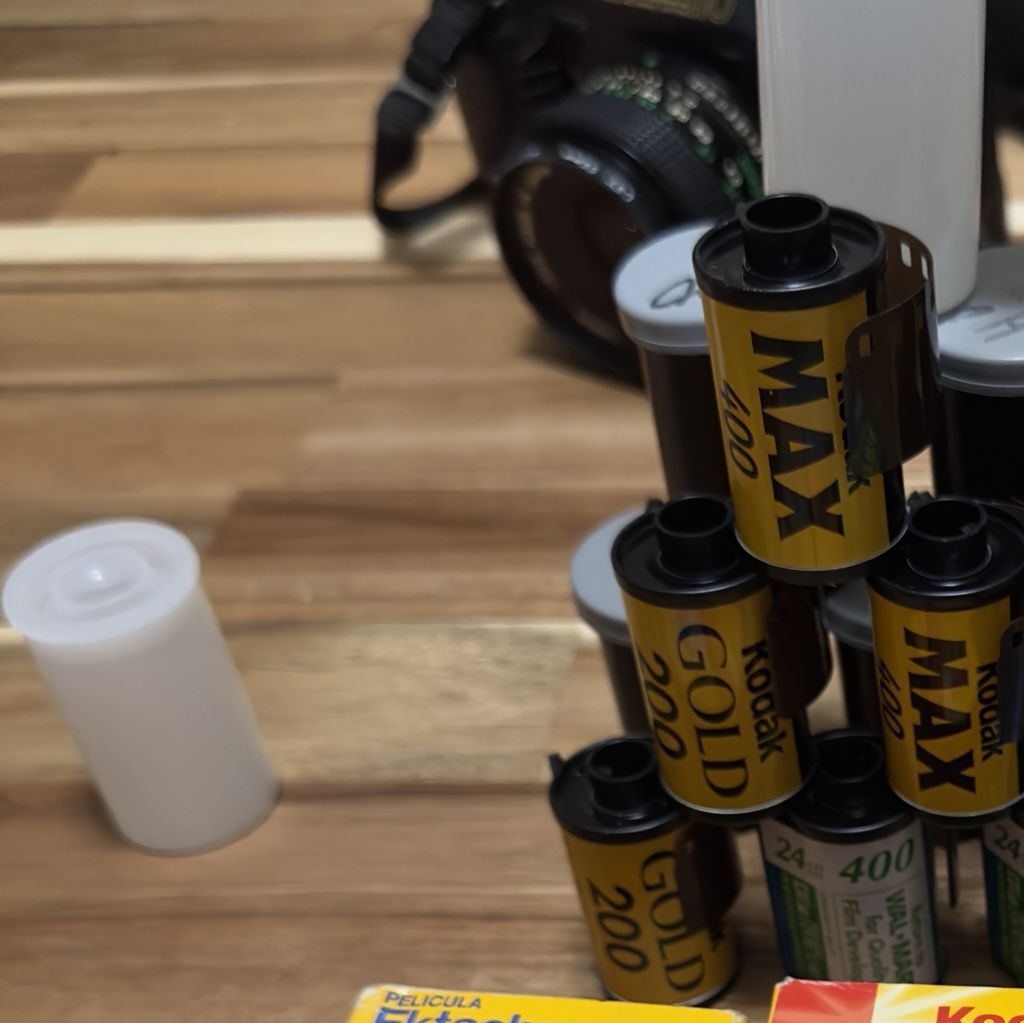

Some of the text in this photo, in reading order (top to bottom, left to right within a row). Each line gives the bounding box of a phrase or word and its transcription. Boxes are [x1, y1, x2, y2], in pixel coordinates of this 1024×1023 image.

[722, 380, 759, 480] 400
[750, 330, 845, 542] MAX
[637, 644, 687, 761] 200
[676, 623, 750, 799] GOLD
[741, 639, 784, 763] Kodak
[903, 626, 977, 795] MAX
[975, 662, 1004, 762] Kodak
[776, 836, 806, 870] 24
[838, 838, 915, 885] 400
[993, 824, 1021, 860] 24
[586, 876, 651, 973] 200
[641, 850, 705, 992] GOLD
[384, 990, 482, 1010] PELICULA
